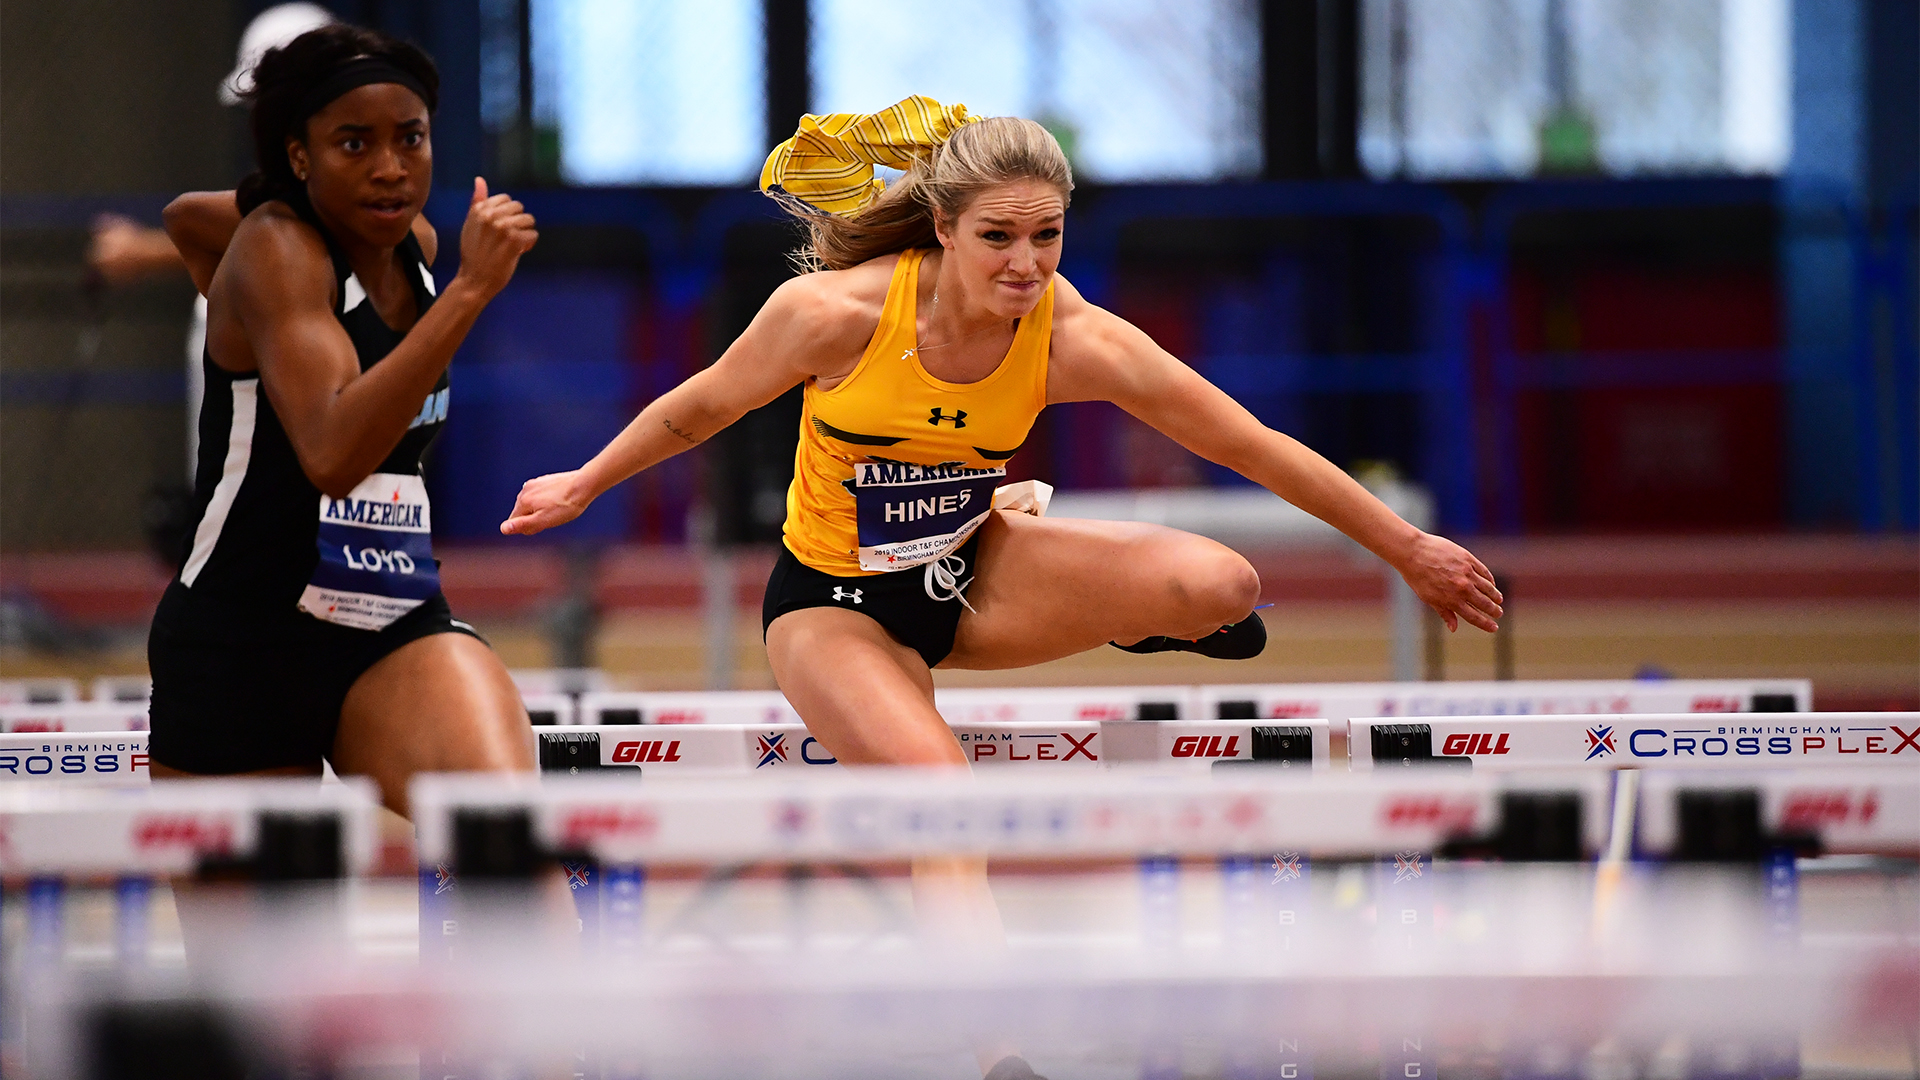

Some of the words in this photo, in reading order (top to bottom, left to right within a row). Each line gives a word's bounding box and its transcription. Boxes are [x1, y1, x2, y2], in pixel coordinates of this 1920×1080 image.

[326, 497, 423, 528] AMERICAN
[884, 488, 973, 523] HINES
[343, 544, 416, 575] LOYD
[891, 544, 918, 556] INDOOR
[919, 541, 933, 550] T&F
[896, 550, 935, 562] BIRMINGHAM
[1717, 726, 1842, 735] BIRMINGHAM
[42, 743, 150, 753] BIRMINGH
[611, 740, 682, 763] GILL
[1171, 735, 1240, 758] GILL
[1442, 733, 1511, 756] GILL
